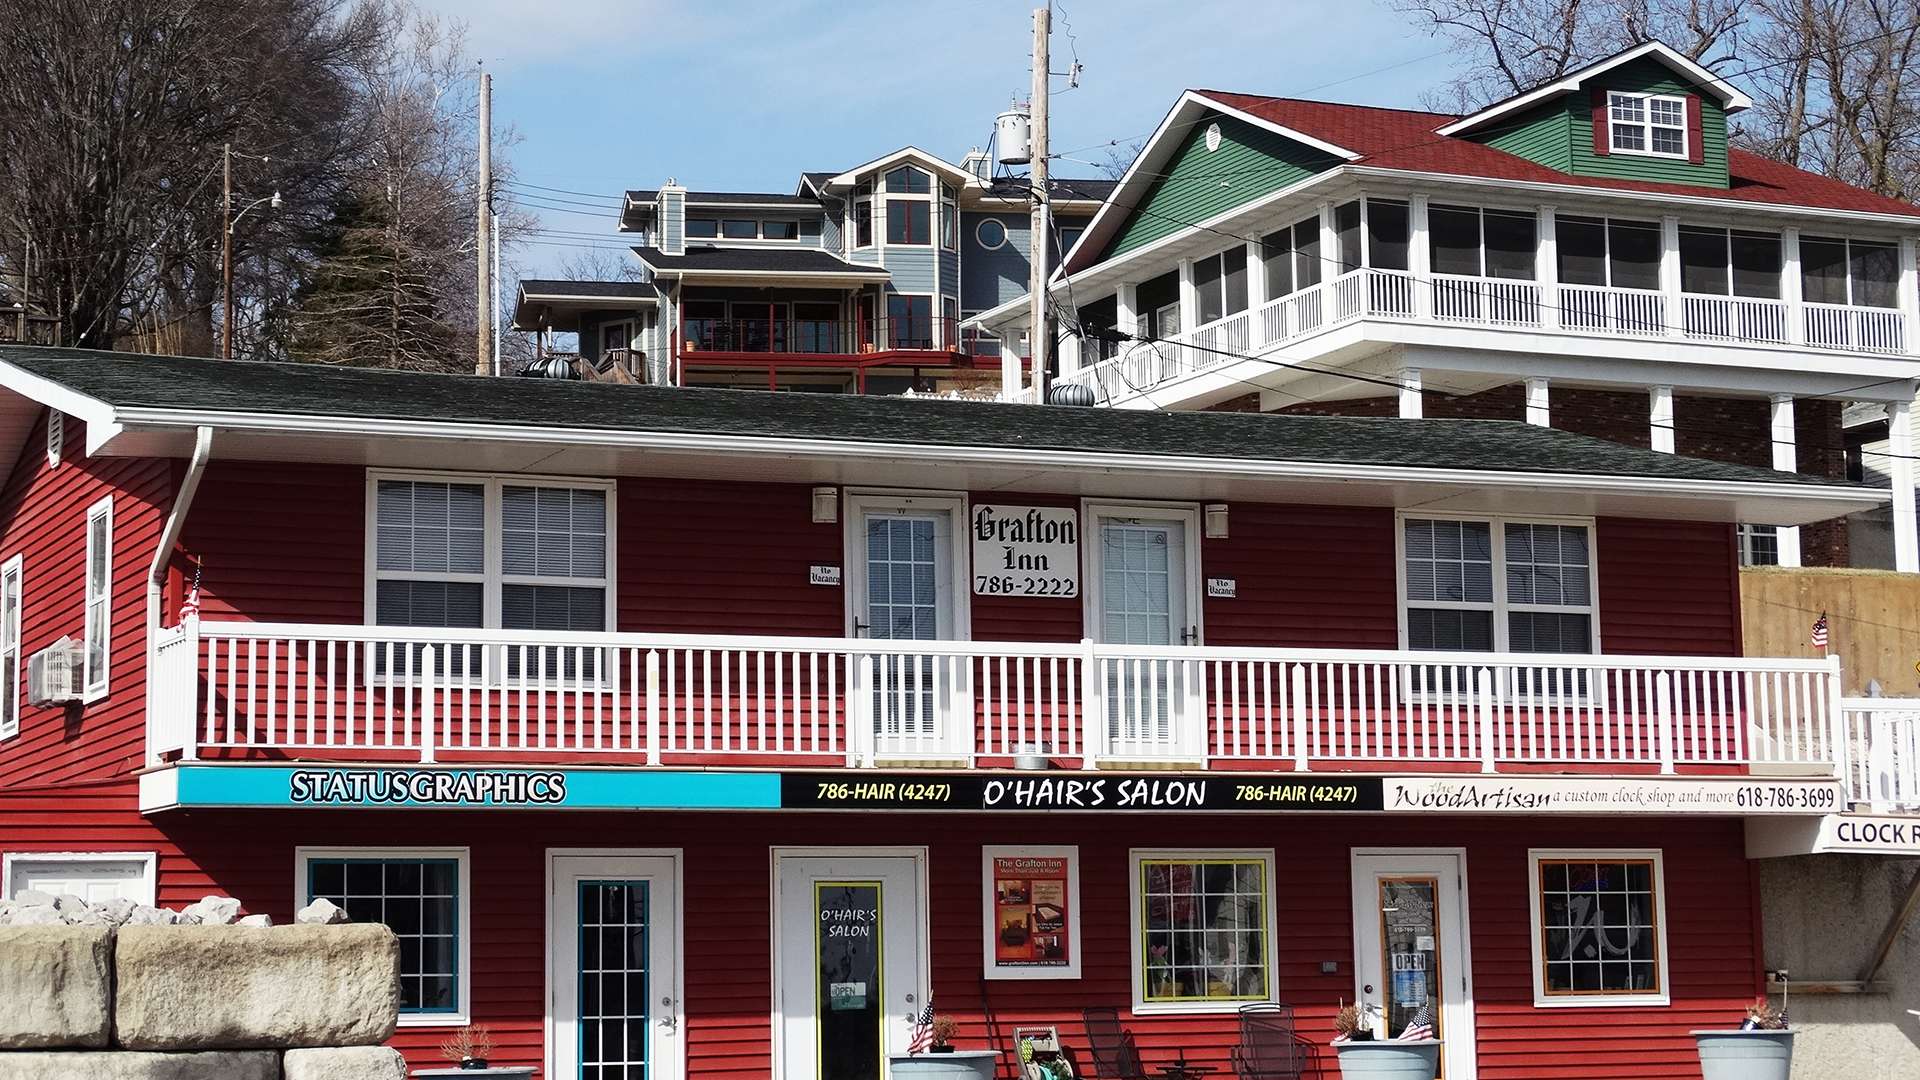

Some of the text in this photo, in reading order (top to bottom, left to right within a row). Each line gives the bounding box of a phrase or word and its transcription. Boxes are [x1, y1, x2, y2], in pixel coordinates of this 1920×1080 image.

[974, 506, 1076, 544] Grafton
[1002, 546, 1050, 570] Inn
[976, 576, 1075, 595] 786-2222
[289, 770, 567, 804] STATUSGRAPHICS
[817, 783, 951, 802] 786-HAIR (4247)
[983, 778, 1206, 807] O'HAIR'S SALON
[1235, 785, 1358, 803] 786-HAIR (4247)
[1394, 785, 1551, 809] WoodArtisan
[1429, 782, 1454, 794] the
[1552, 787, 1735, 808] a custom clock shop and more
[1736, 787, 1835, 808] 618-786-3699
[1837, 822, 1906, 844] CLOCK
[997, 859, 1062, 868] The Grafton Inn
[820, 908, 877, 921] O'HAIR'S
[829, 924, 870, 937] SALON
[1395, 954, 1425, 970] OPEN
